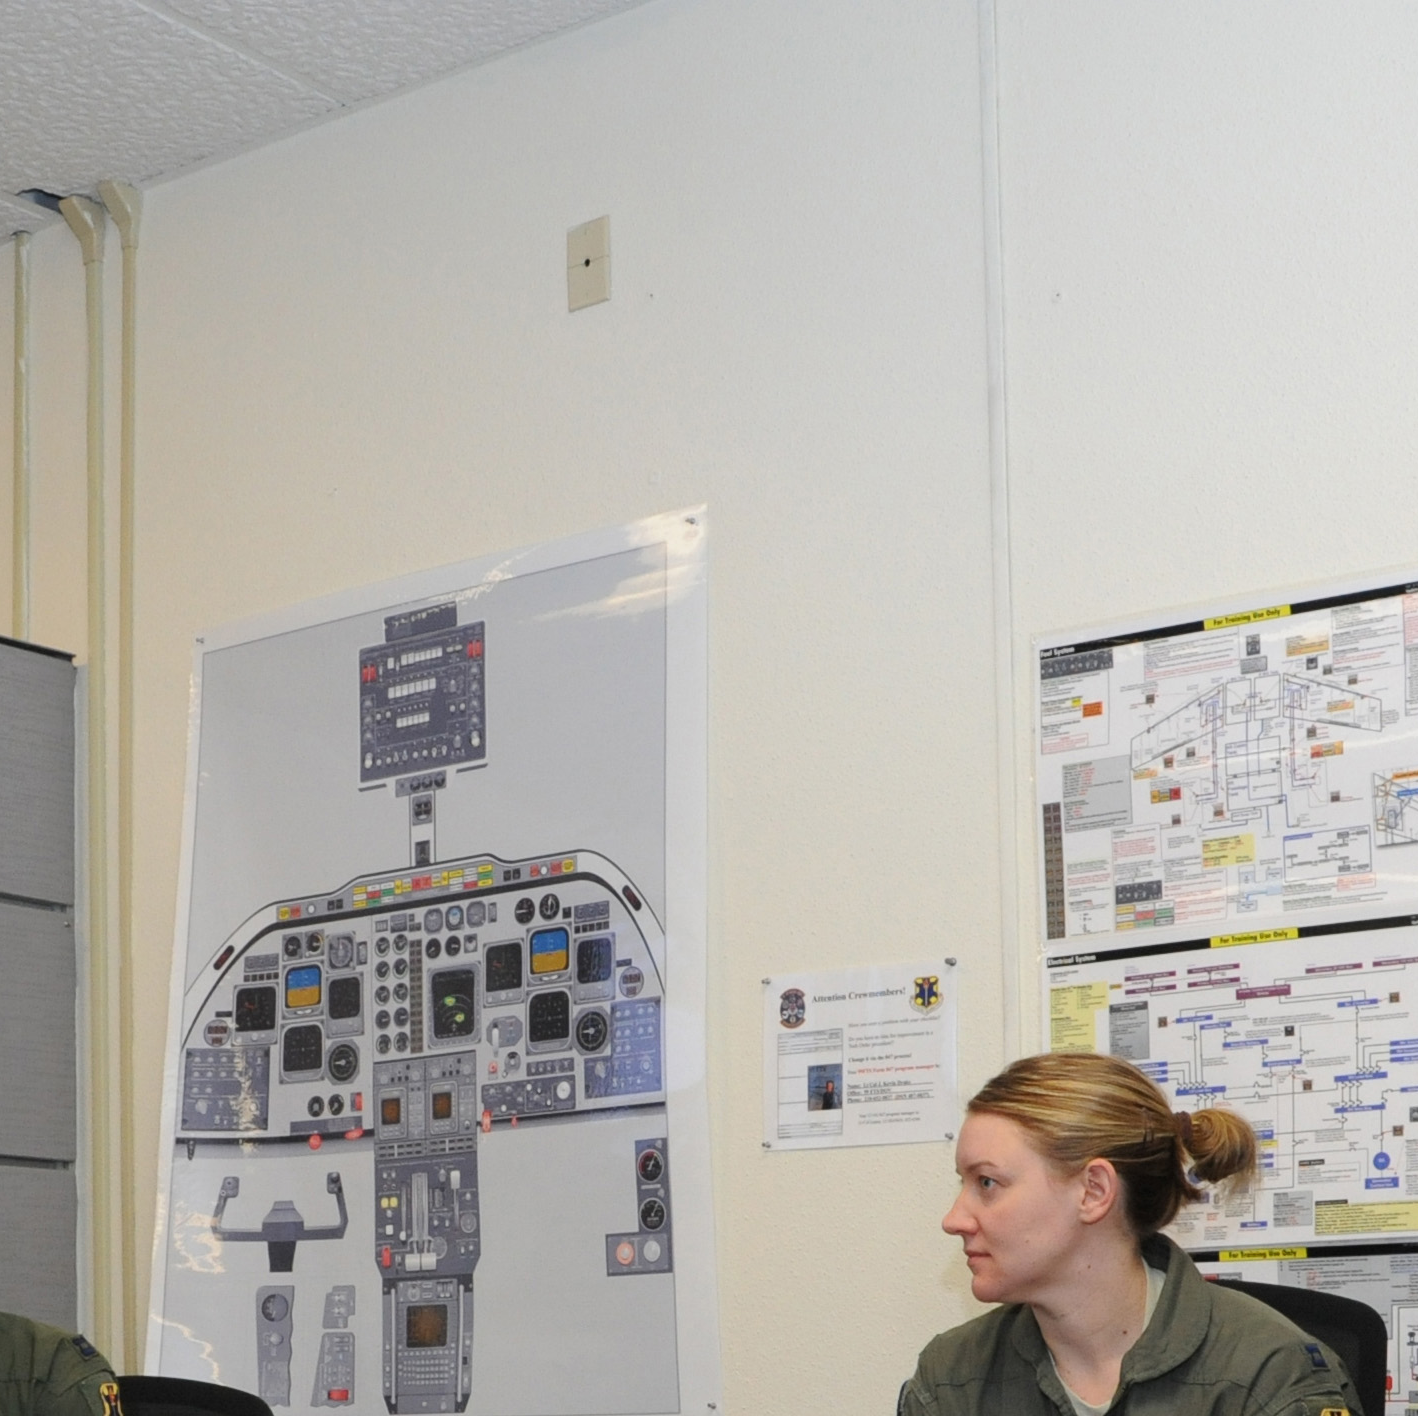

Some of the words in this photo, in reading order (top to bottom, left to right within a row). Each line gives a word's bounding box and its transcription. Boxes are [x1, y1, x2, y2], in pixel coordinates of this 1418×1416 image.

[1225, 614, 1251, 626] Training
[1253, 612, 1264, 620] Use
[1266, 608, 1281, 619] Only
[1232, 934, 1258, 944] Training
[1272, 930, 1288, 940] Only
[812, 994, 846, 1003] Attention
[848, 987, 906, 999] Crewmembers!
[1240, 1250, 1267, 1260] Training
[1281, 1249, 1297, 1258] Only
